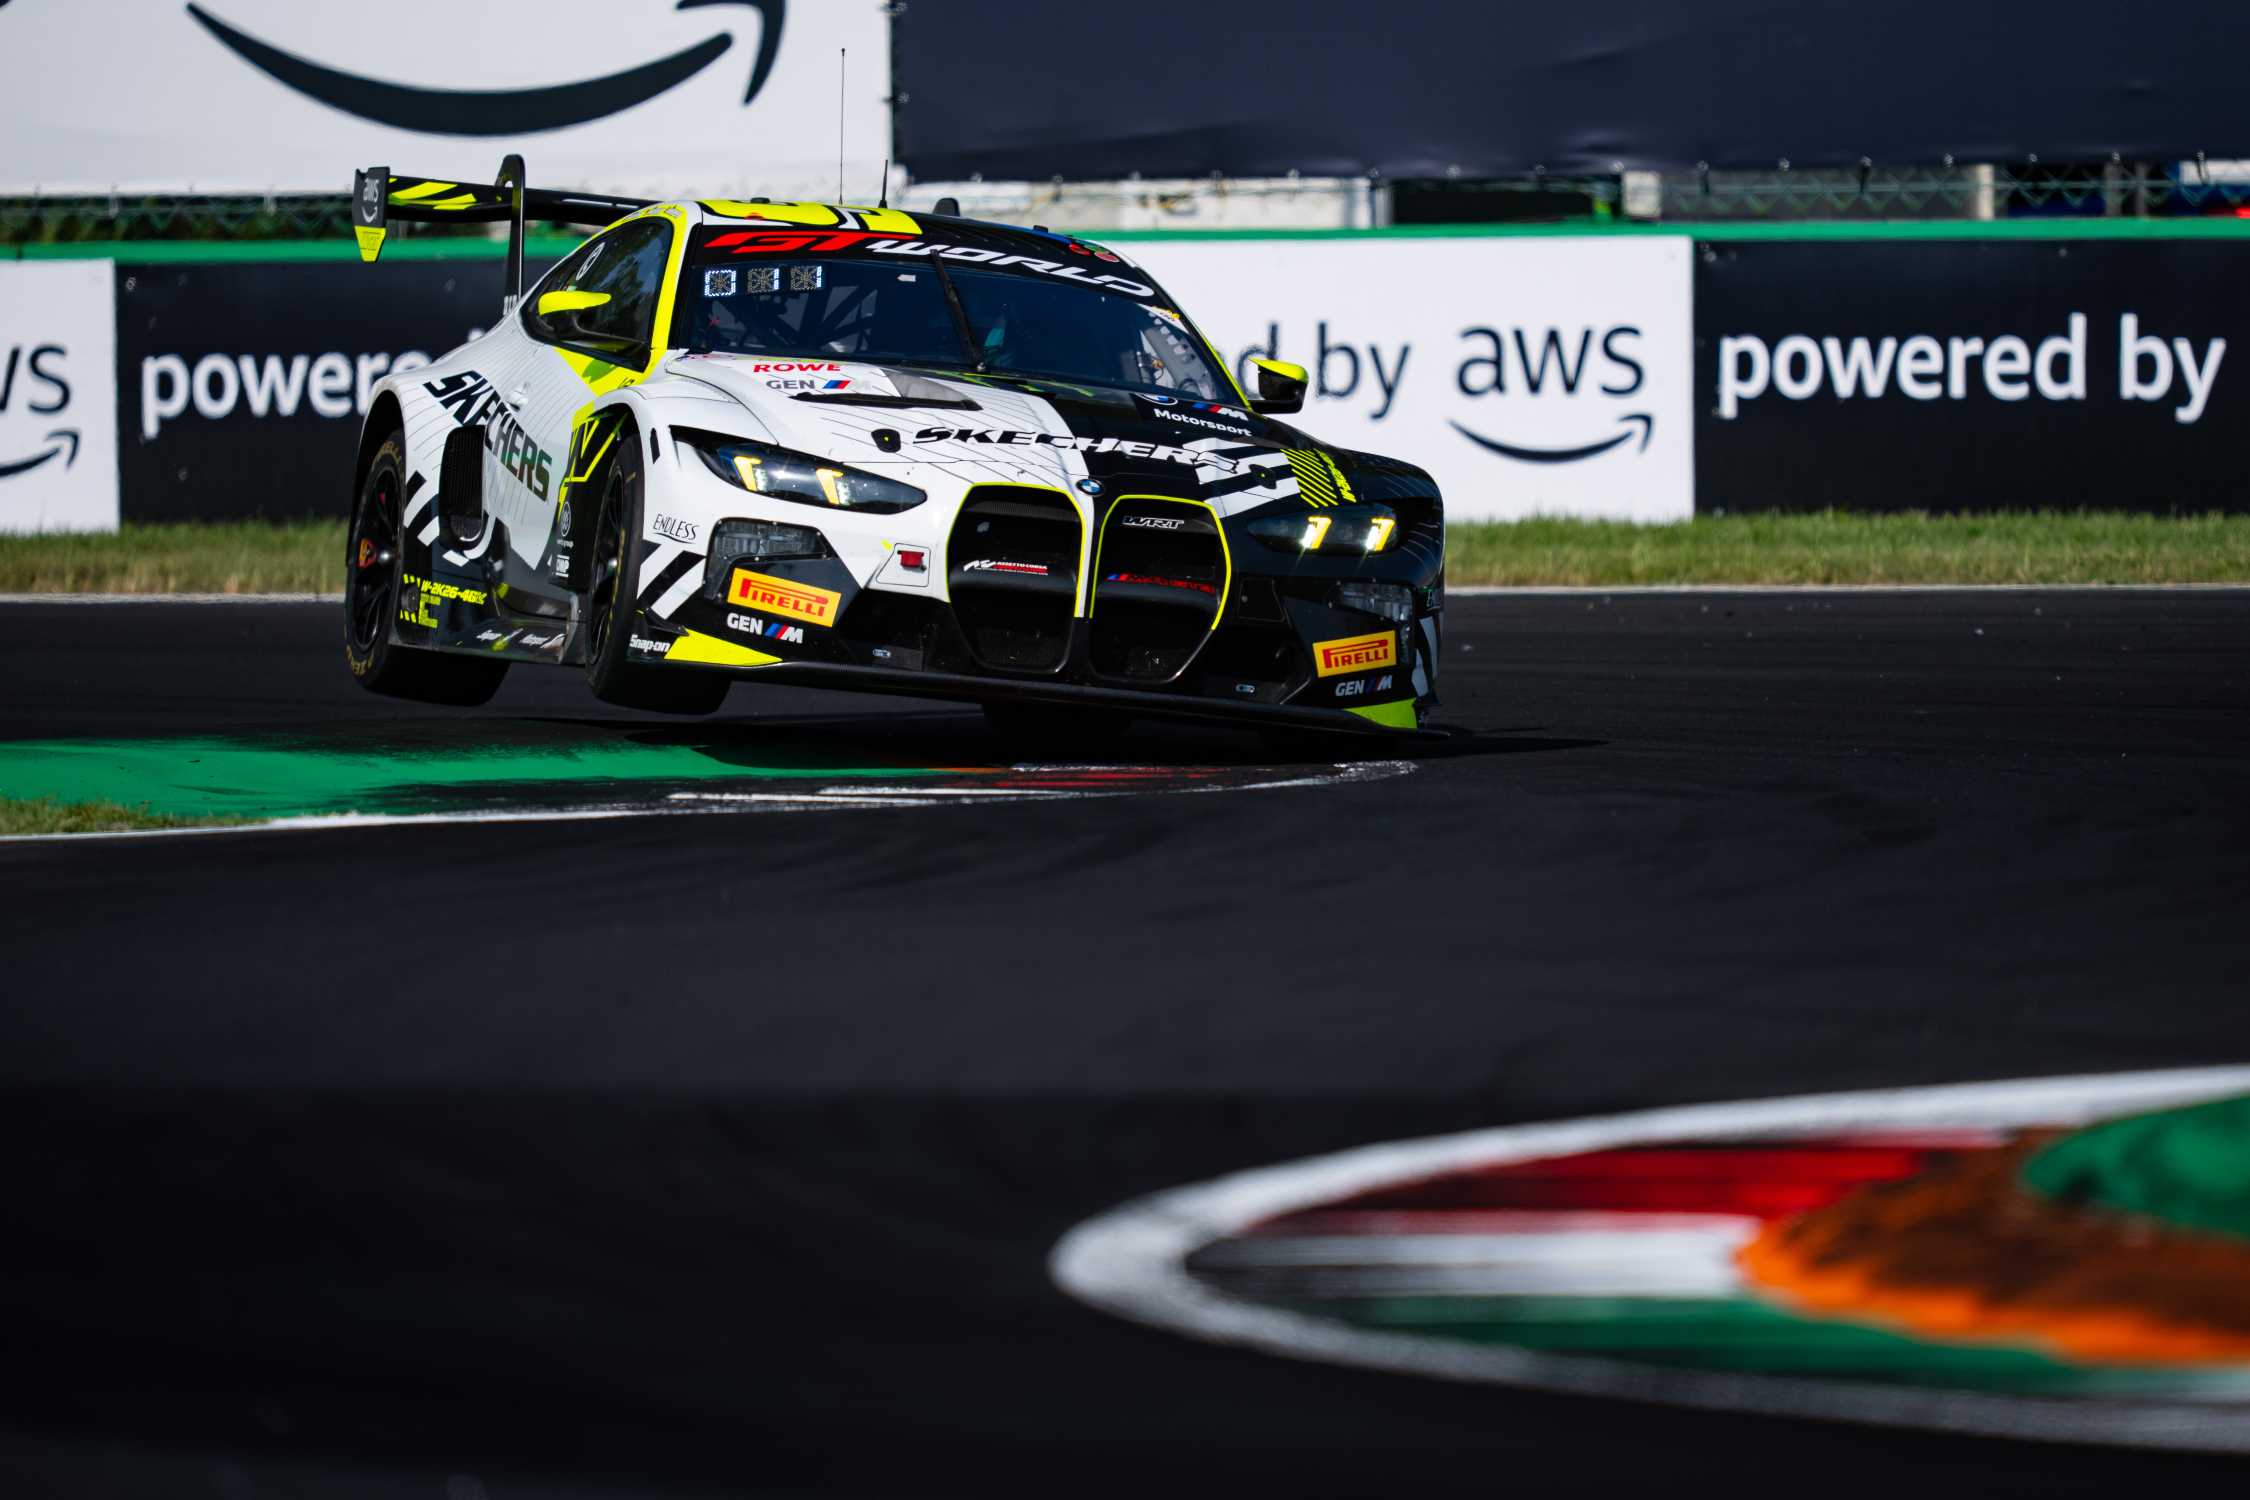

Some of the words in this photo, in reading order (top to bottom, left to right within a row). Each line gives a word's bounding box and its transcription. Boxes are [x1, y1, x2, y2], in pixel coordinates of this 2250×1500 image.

[704, 230, 916, 254] GT
[865, 240, 1155, 297] WORLD
[753, 363, 841, 373] ROWE
[1315, 321, 1412, 421] by
[1455, 325, 1645, 397] aws
[1718, 312, 2087, 420] powered
[2120, 312, 2227, 423] by
[140, 328, 486, 439] power
[766, 380, 816, 390] GEN
[423, 370, 552, 502] SKECHERS
[1153, 408, 1253, 437] Motorsport
[913, 426, 1239, 475] SKECHERS
[653, 513, 700, 541] ENDLESS
[1123, 516, 1184, 530] WRT
[739, 578, 829, 617] PIRELLI
[727, 612, 764, 636] GEN
[629, 634, 671, 653] Snap-on
[1322, 639, 1389, 669] PIRELLI
[1335, 680, 1365, 697] GEN
